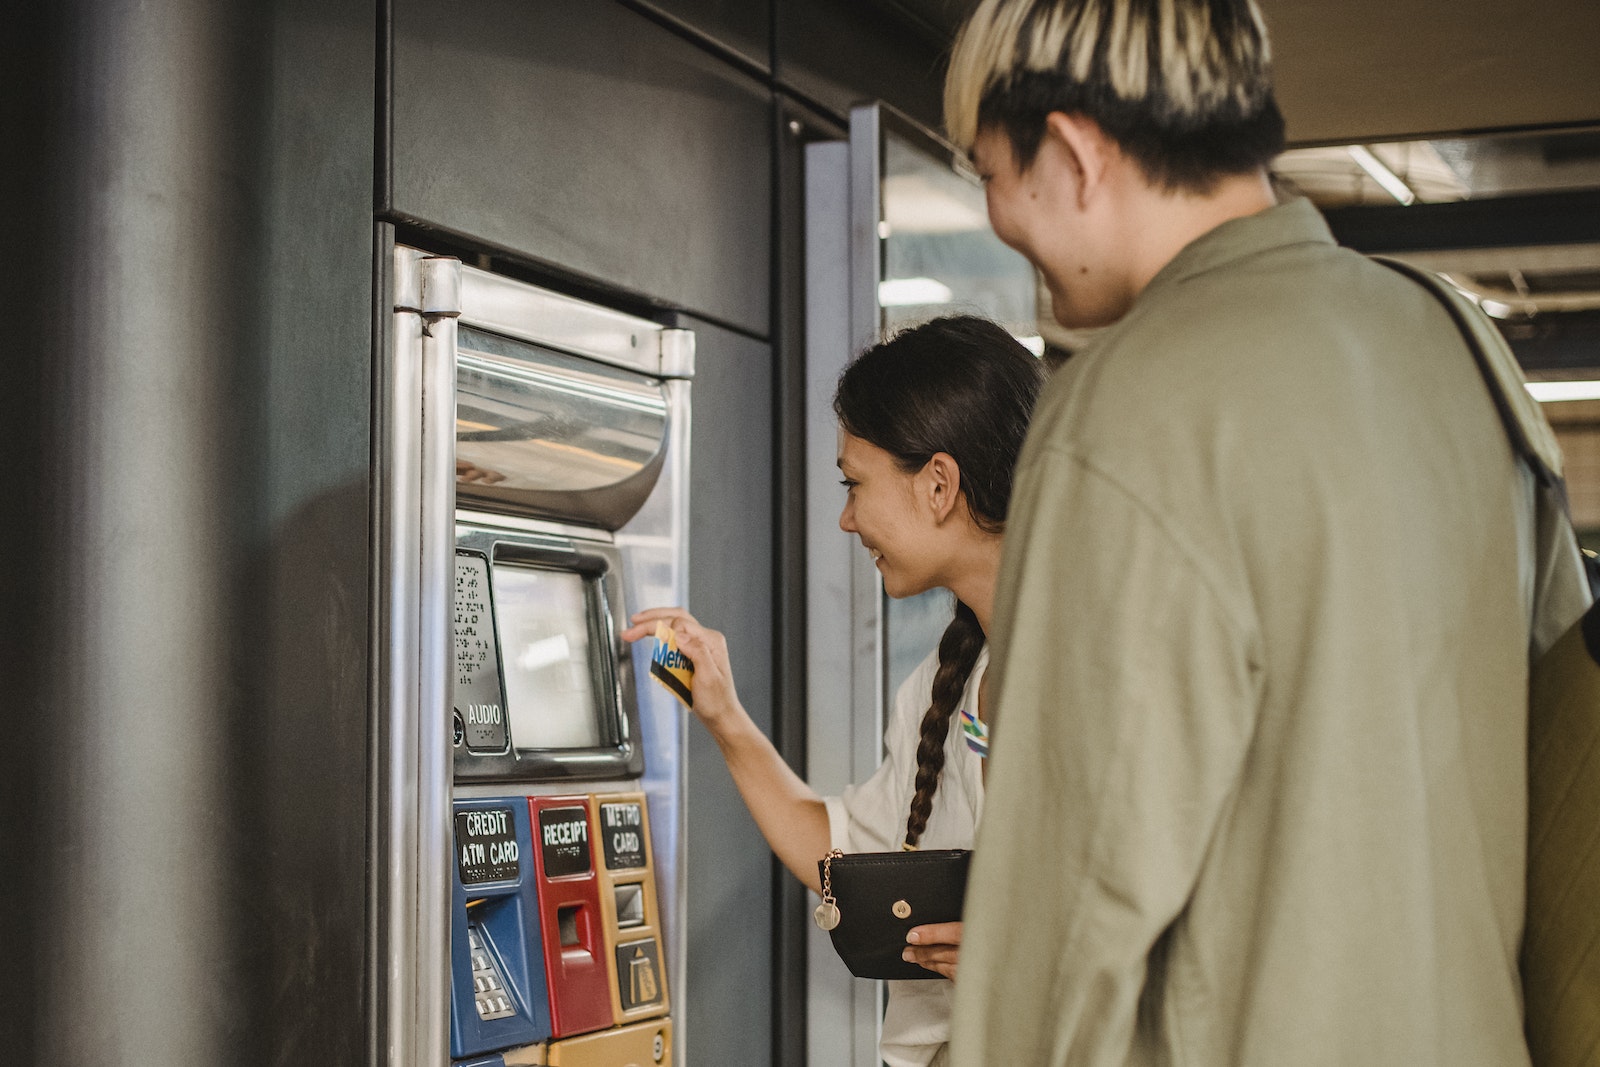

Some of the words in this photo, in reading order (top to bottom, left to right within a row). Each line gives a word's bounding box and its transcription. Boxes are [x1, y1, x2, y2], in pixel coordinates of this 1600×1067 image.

[469, 704, 501, 725] AUDIO
[467, 811, 507, 837] CREDIT
[606, 806, 640, 828] METRO
[543, 820, 587, 846] RECEIPT
[613, 832, 639, 854] CARD
[462, 843, 486, 867] ATM
[490, 840, 519, 865] CARD
